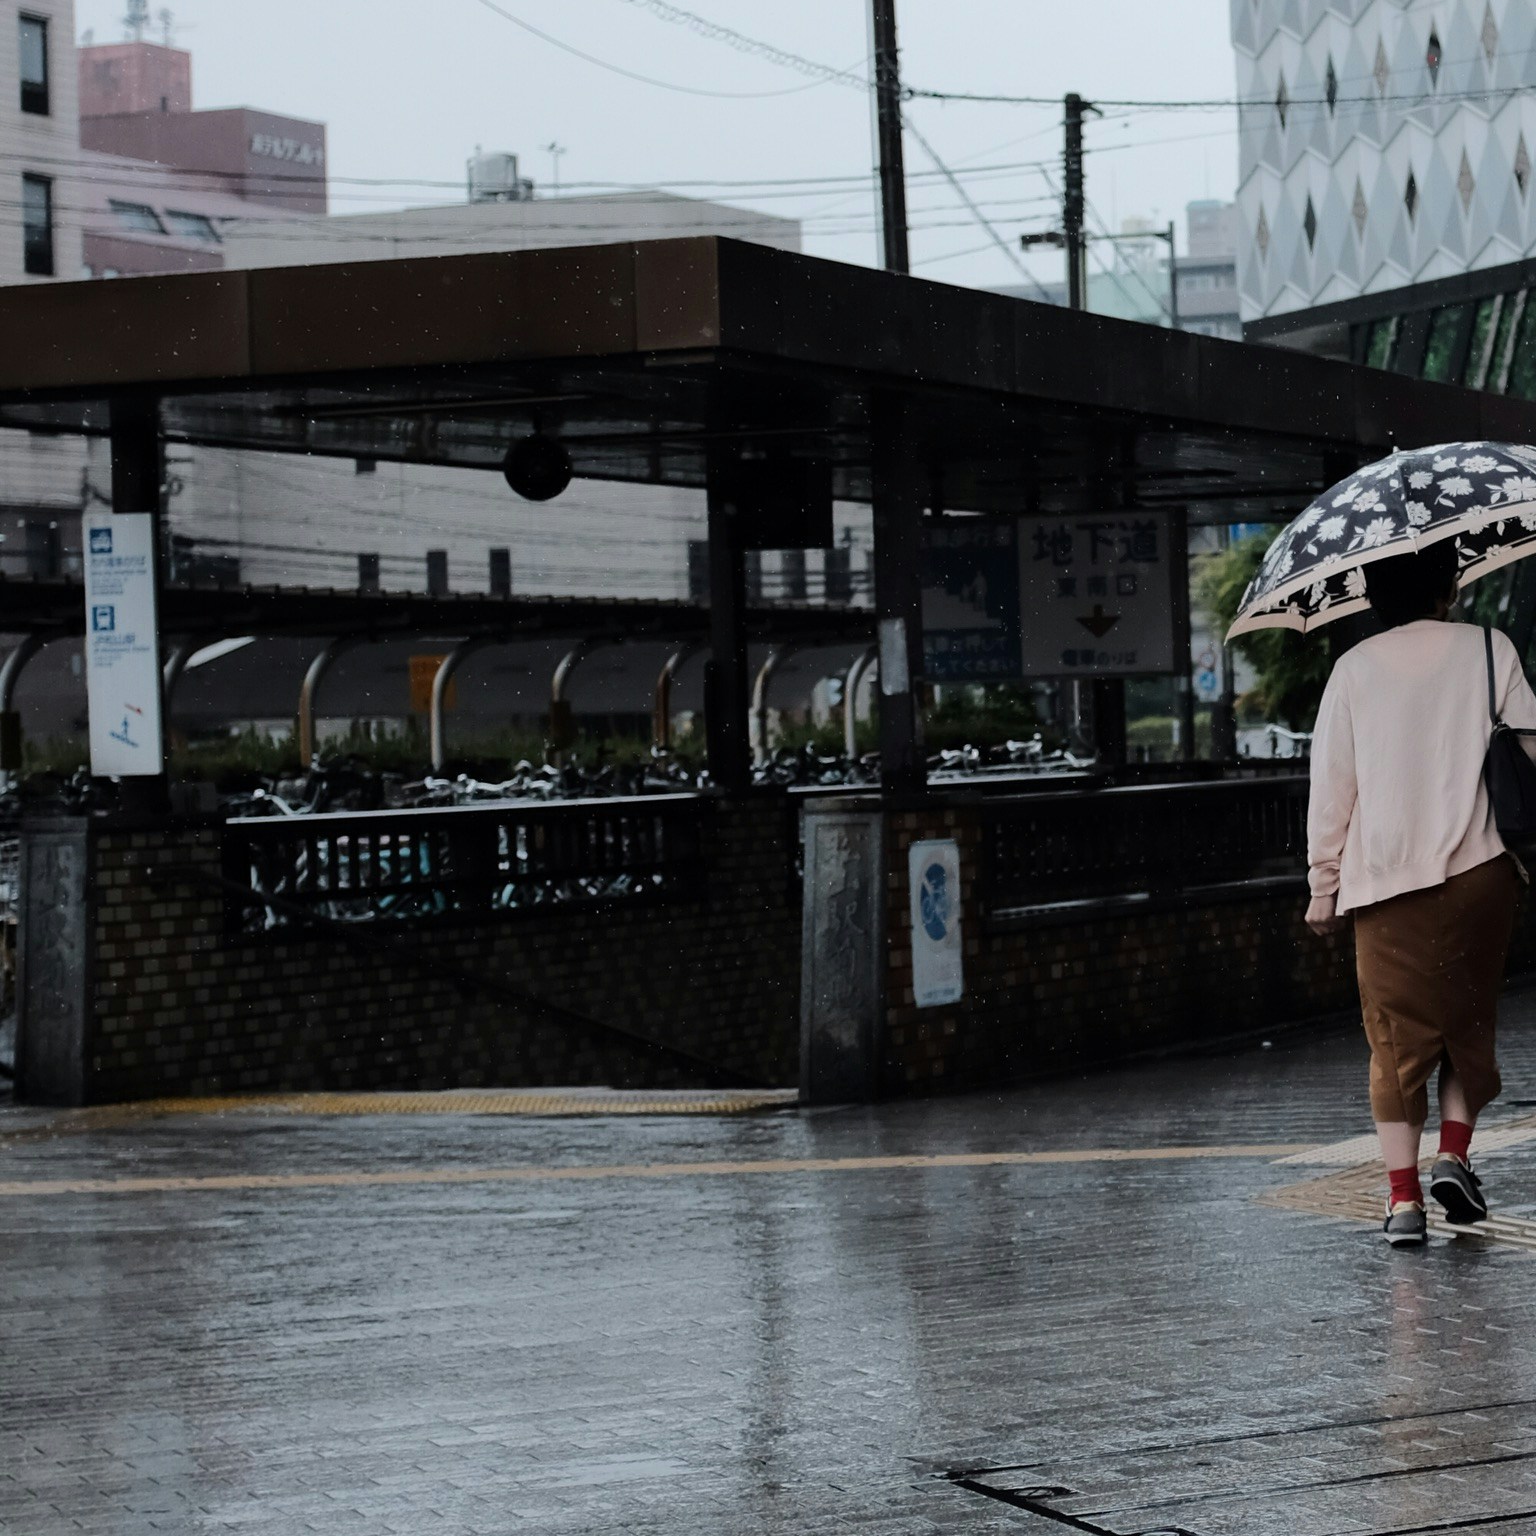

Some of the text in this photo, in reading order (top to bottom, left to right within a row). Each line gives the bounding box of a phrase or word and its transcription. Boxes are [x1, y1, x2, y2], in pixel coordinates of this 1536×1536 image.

[1031, 519, 1160, 566] 地下道
[1057, 574, 1137, 597] 東南口
[1061, 648, 1137, 666] 電車のりば
